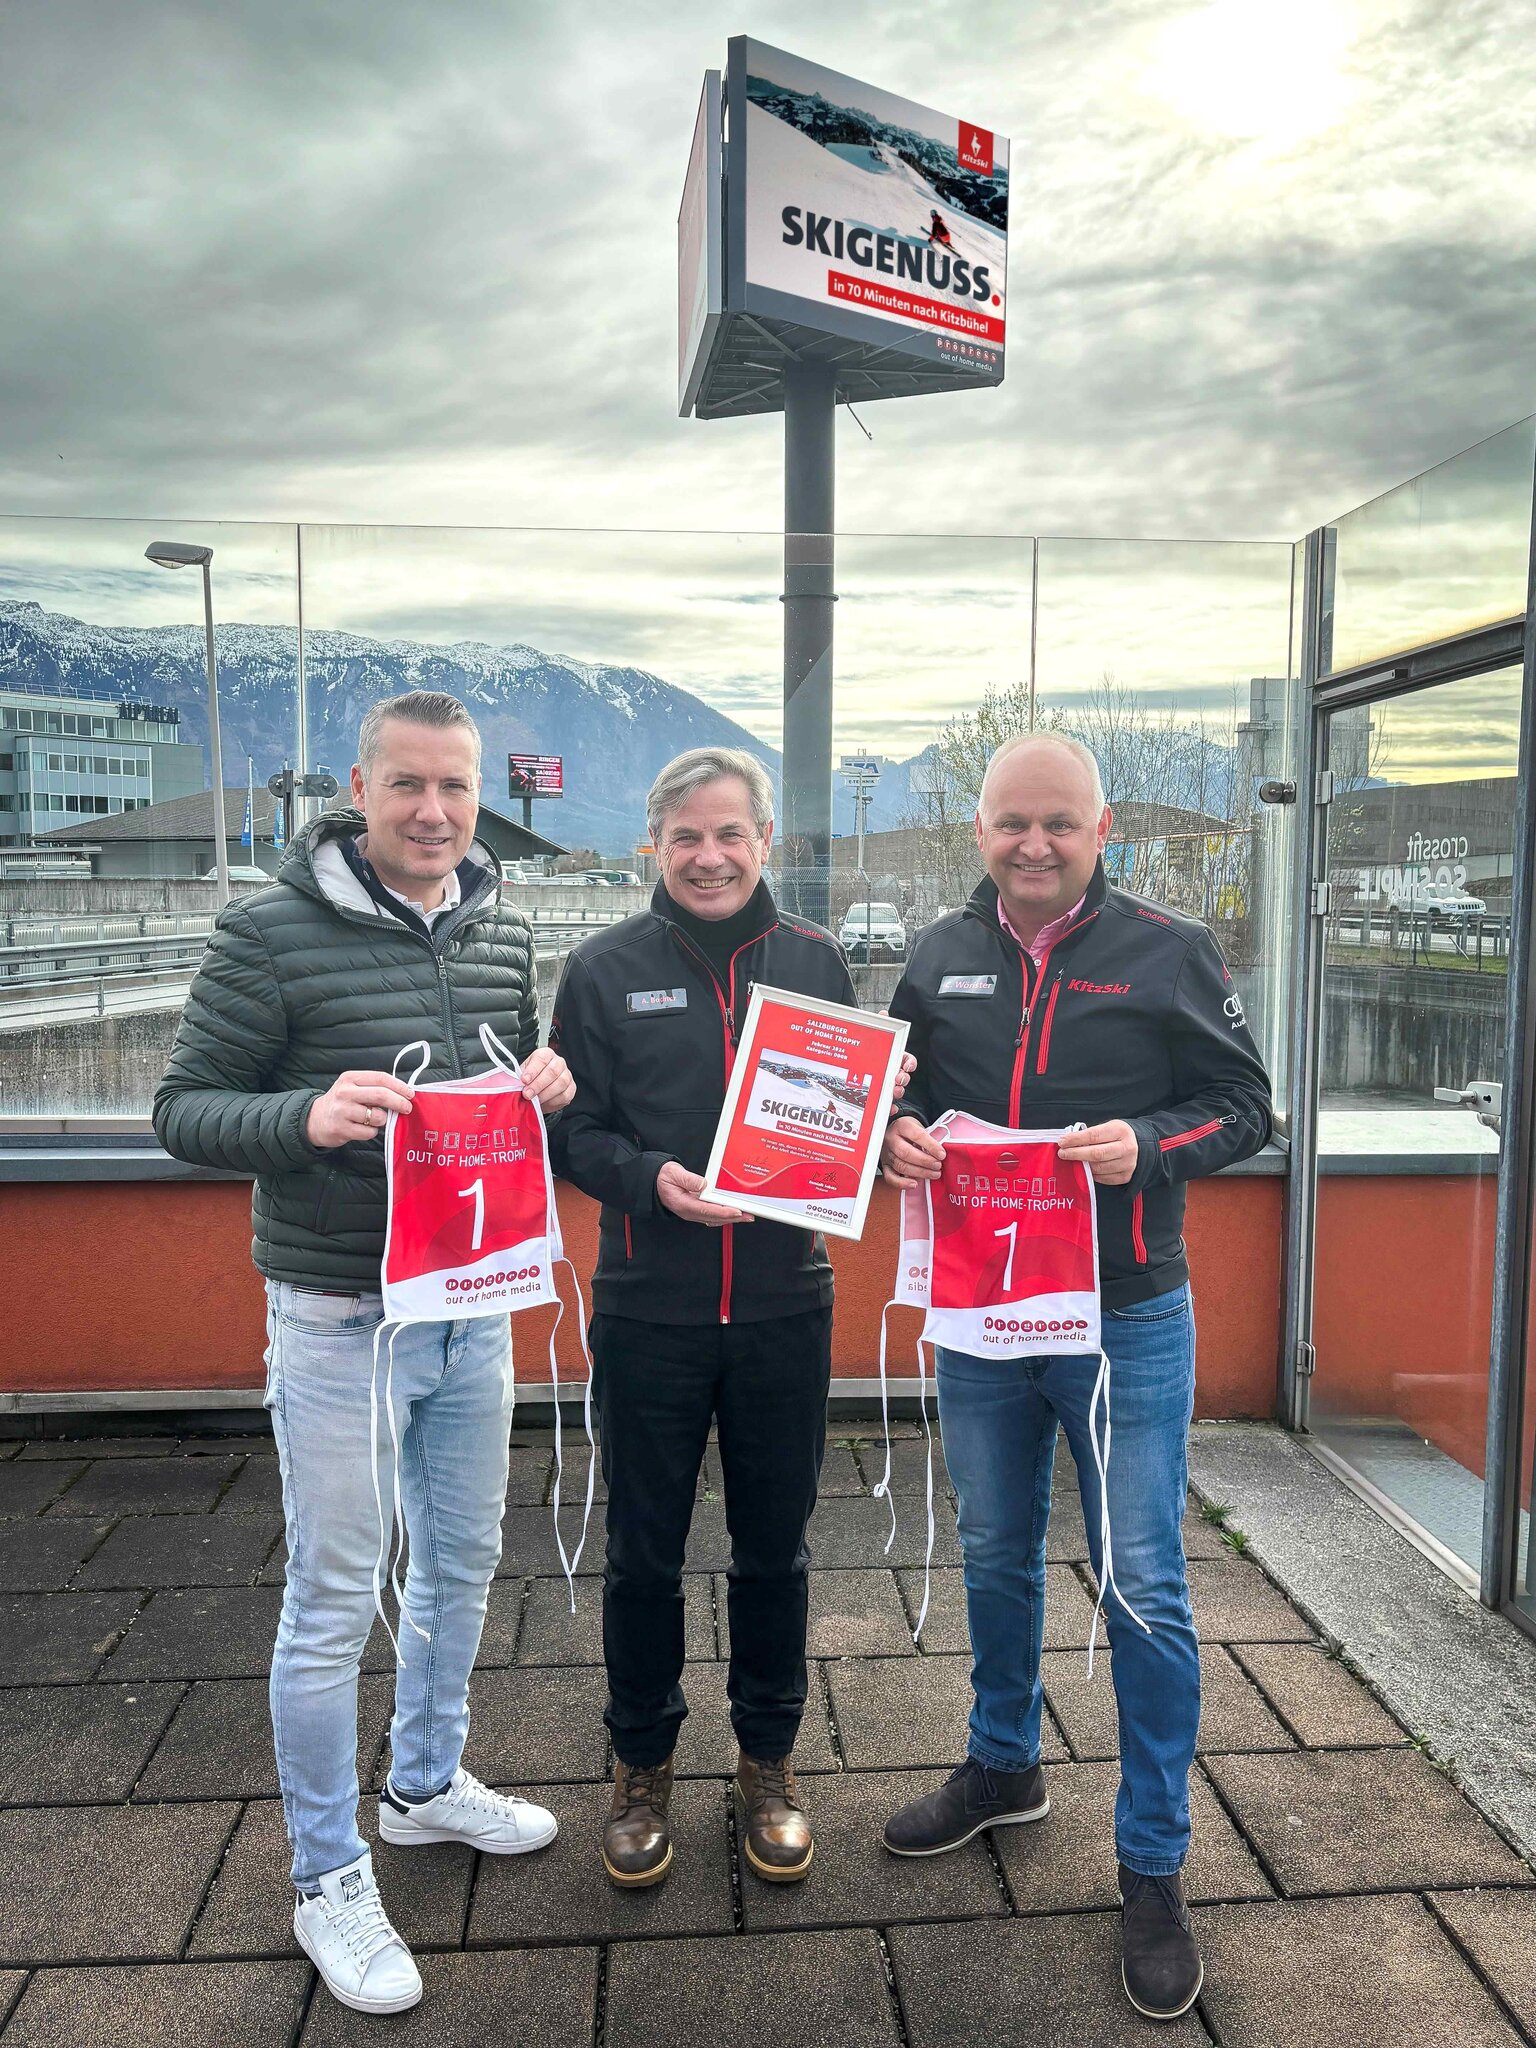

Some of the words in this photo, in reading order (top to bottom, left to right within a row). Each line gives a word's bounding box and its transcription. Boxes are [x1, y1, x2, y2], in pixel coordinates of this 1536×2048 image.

[962, 153, 988, 169] KitzSki
[781, 206, 1001, 307] SKIGENUSS.
[833, 278, 845, 293] in
[847, 283, 861, 297] 70
[864, 287, 910, 311] Minuten
[913, 304, 938, 319] nach
[940, 309, 989, 334] Kitzbühel
[936, 337, 997, 364] progress
[940, 353, 951, 361] out
[951, 354, 958, 362] of
[959, 356, 975, 367] home
[976, 362, 993, 372] media
[1067, 978, 1131, 994] KitzSki
[807, 1019, 848, 1035] SALZBURGER
[1231, 1018, 1247, 1030] Aud
[790, 1023, 804, 1032] OUT
[804, 1027, 813, 1035] OF
[814, 1029, 833, 1040] HOME
[835, 1035, 861, 1047] TROPHY
[811, 1040, 831, 1050] Februar
[760, 1099, 857, 1136] SKIGENUSS.
[791, 1125, 812, 1136] Minuten
[812, 1131, 824, 1139] nach
[406, 1149, 434, 1164] OUT
[437, 1154, 455, 1167] OF
[459, 1147, 527, 1167] HOME-TROPHY
[949, 1193, 968, 1207] OUT
[971, 1196, 988, 1208] OF
[991, 1195, 1074, 1211] HOME-TROPHY
[457, 1178, 486, 1251] 1
[993, 1221, 1018, 1292] 1
[445, 1294, 464, 1305] out
[467, 1292, 480, 1303] of
[481, 1288, 507, 1301] home
[510, 1281, 541, 1296] media
[982, 1334, 999, 1344] out
[1003, 1334, 1016, 1345] of
[1018, 1335, 1049, 1343] home
[1052, 1331, 1087, 1342] media
